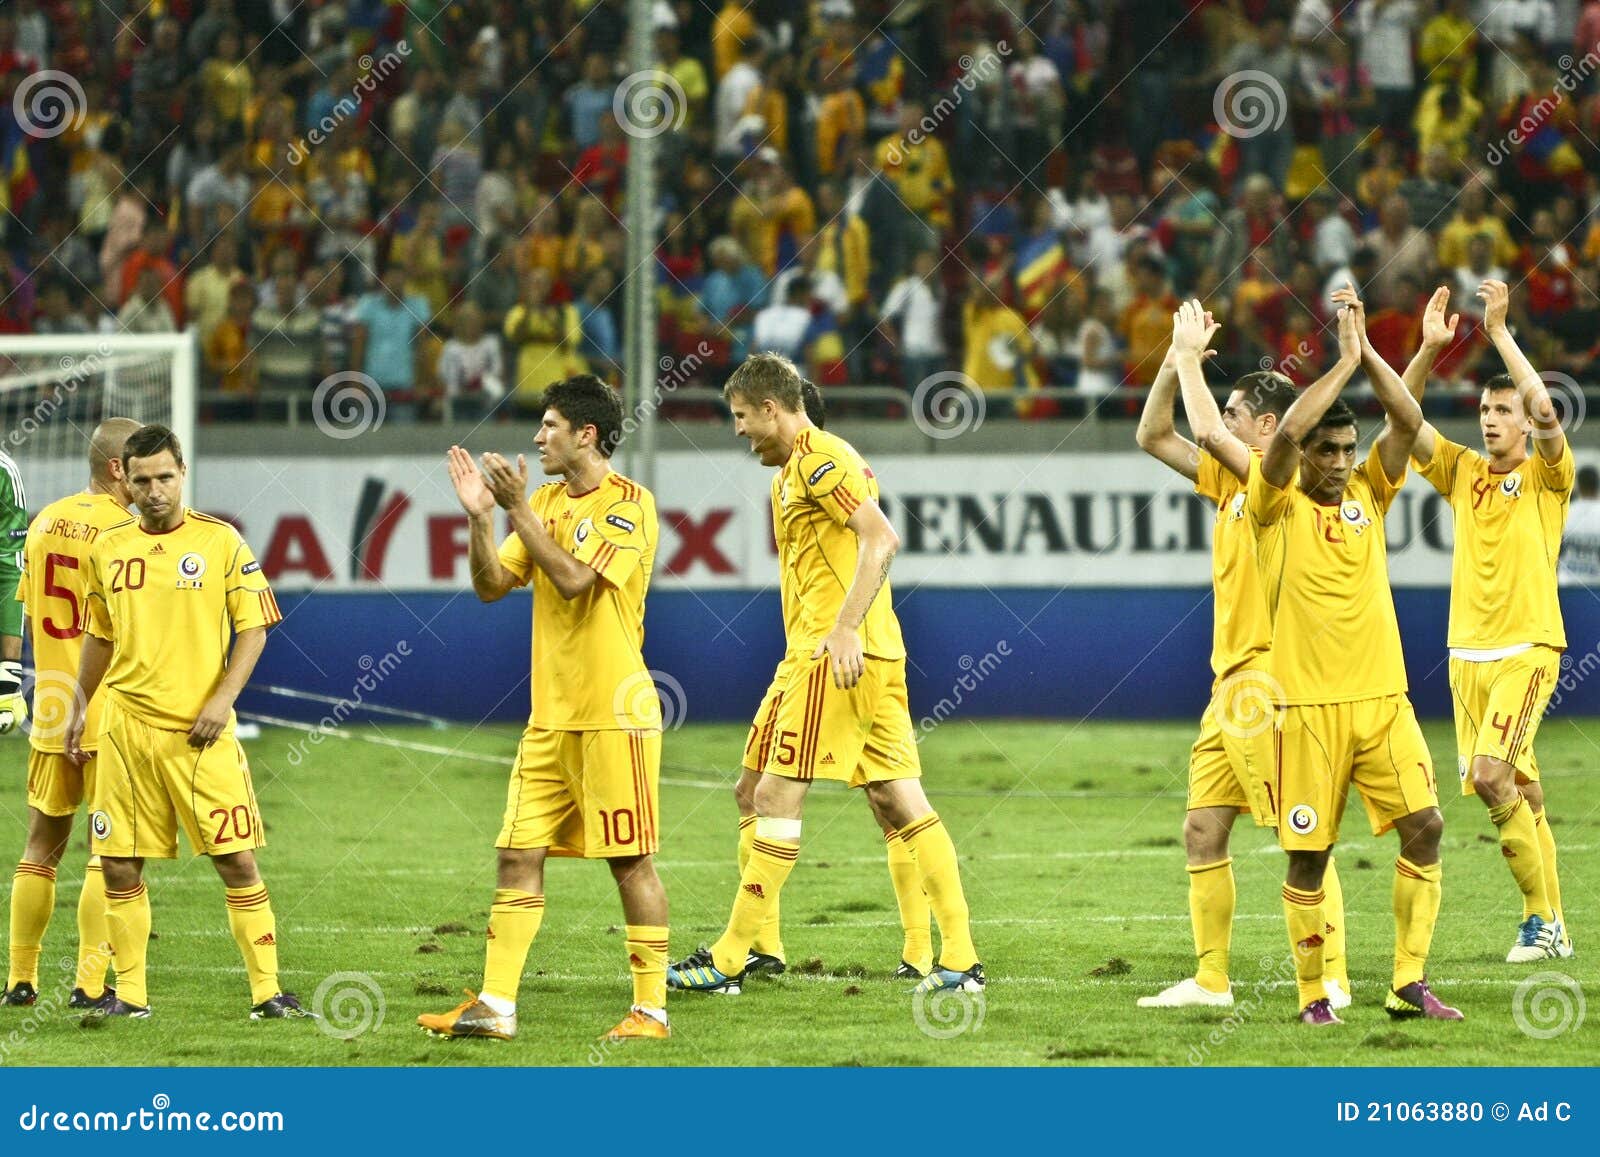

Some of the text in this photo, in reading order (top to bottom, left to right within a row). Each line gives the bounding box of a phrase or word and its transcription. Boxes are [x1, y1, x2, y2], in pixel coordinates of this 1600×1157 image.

[109, 557, 146, 594] 20
[42, 552, 83, 640] 5
[1492, 711, 1512, 746] 4
[209, 804, 251, 844] 20
[599, 808, 635, 847] 10
